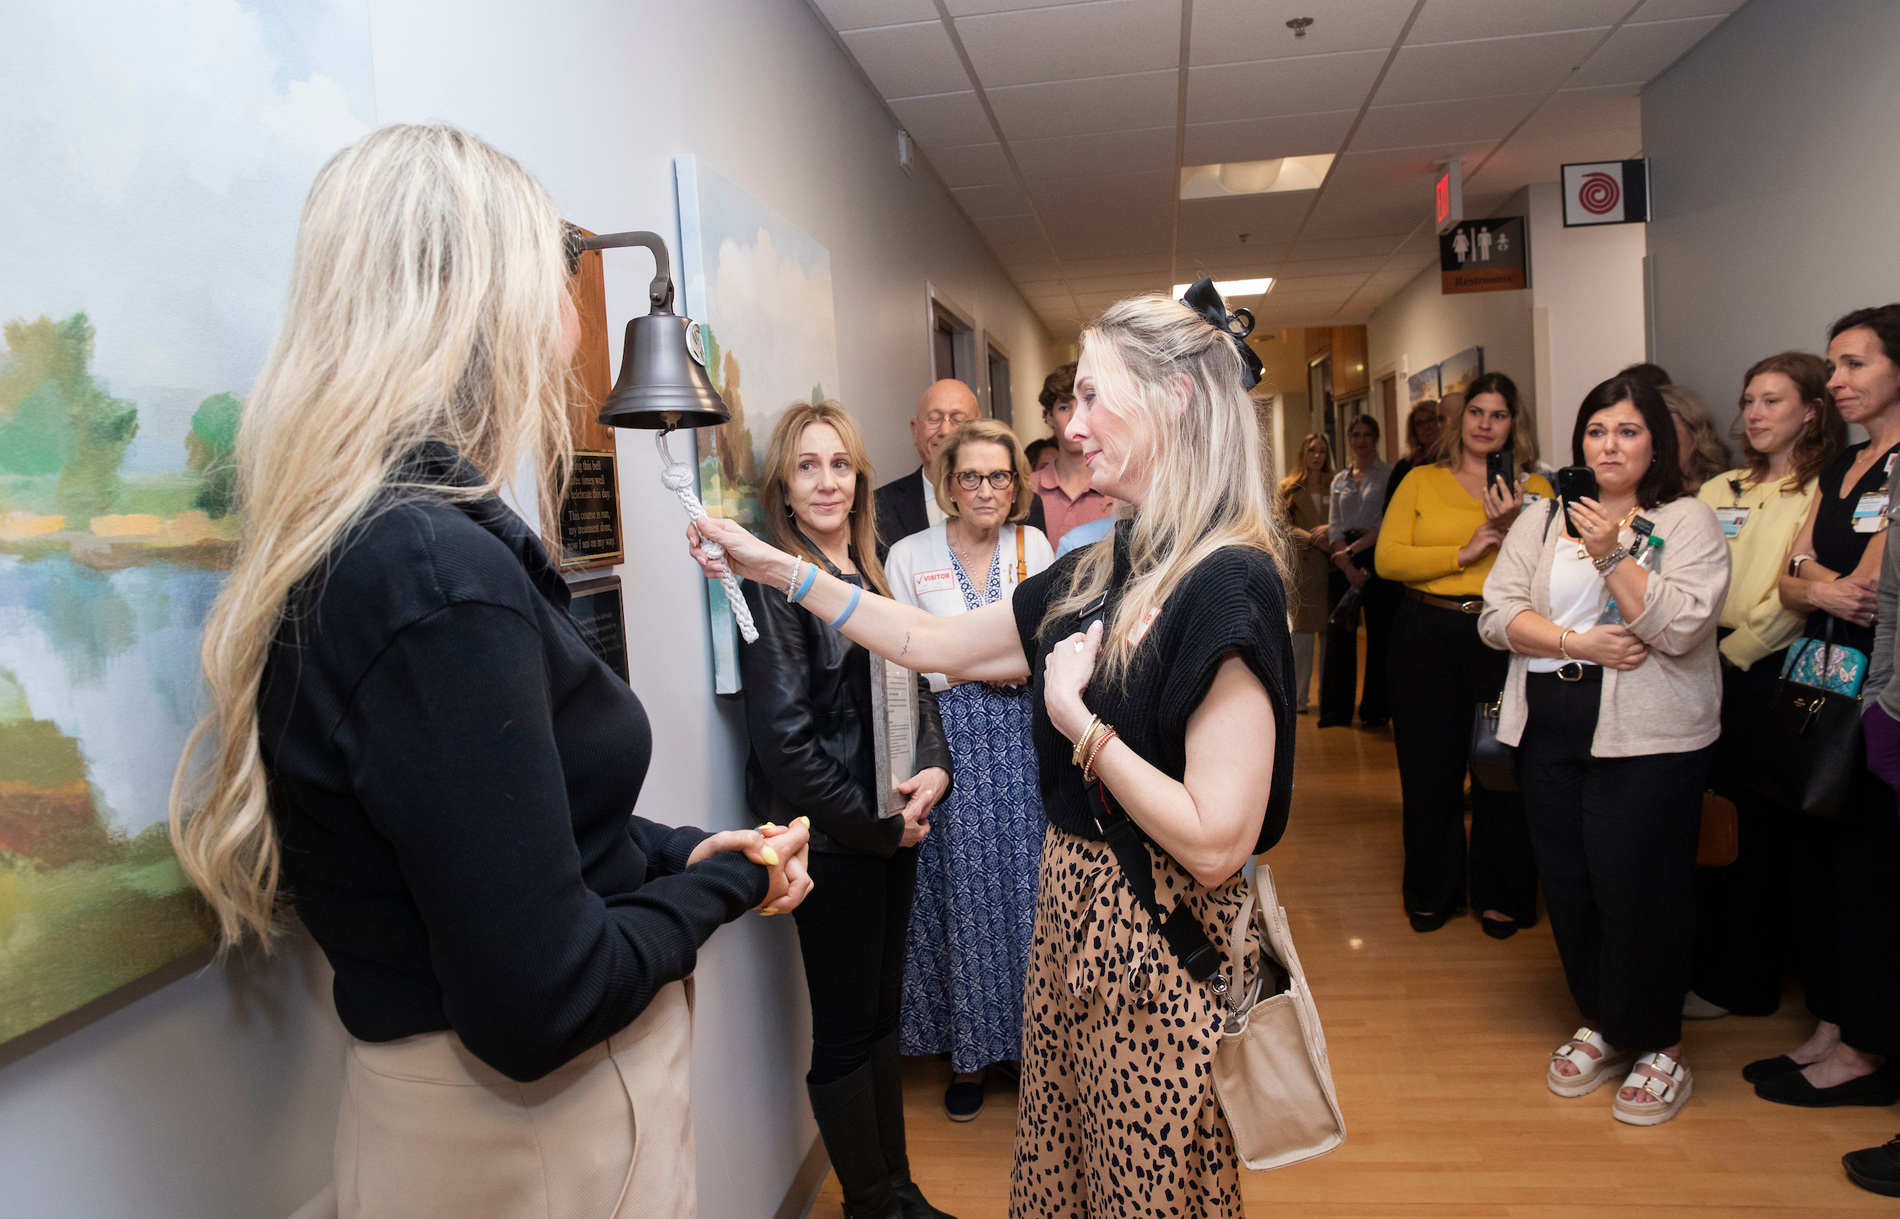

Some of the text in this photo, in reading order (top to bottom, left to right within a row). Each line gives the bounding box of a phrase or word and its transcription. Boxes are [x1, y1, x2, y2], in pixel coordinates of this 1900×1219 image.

[1455, 275, 1512, 288] Restrooms
[583, 460, 592, 471] this
[592, 460, 601, 471] bell
[581, 474, 595, 485] times
[595, 474, 605, 485] well
[571, 488, 592, 500] celebrate
[592, 488, 601, 499] this
[568, 510, 580, 521] This
[580, 511, 596, 520] course
[596, 509, 601, 519] is
[568, 527, 577, 538] my
[577, 524, 599, 534] treatment
[567, 542, 578, 551] now
[582, 540, 590, 549] am
[590, 540, 597, 548] on
[597, 539, 605, 549] my
[923, 573, 951, 582] VISITOR
